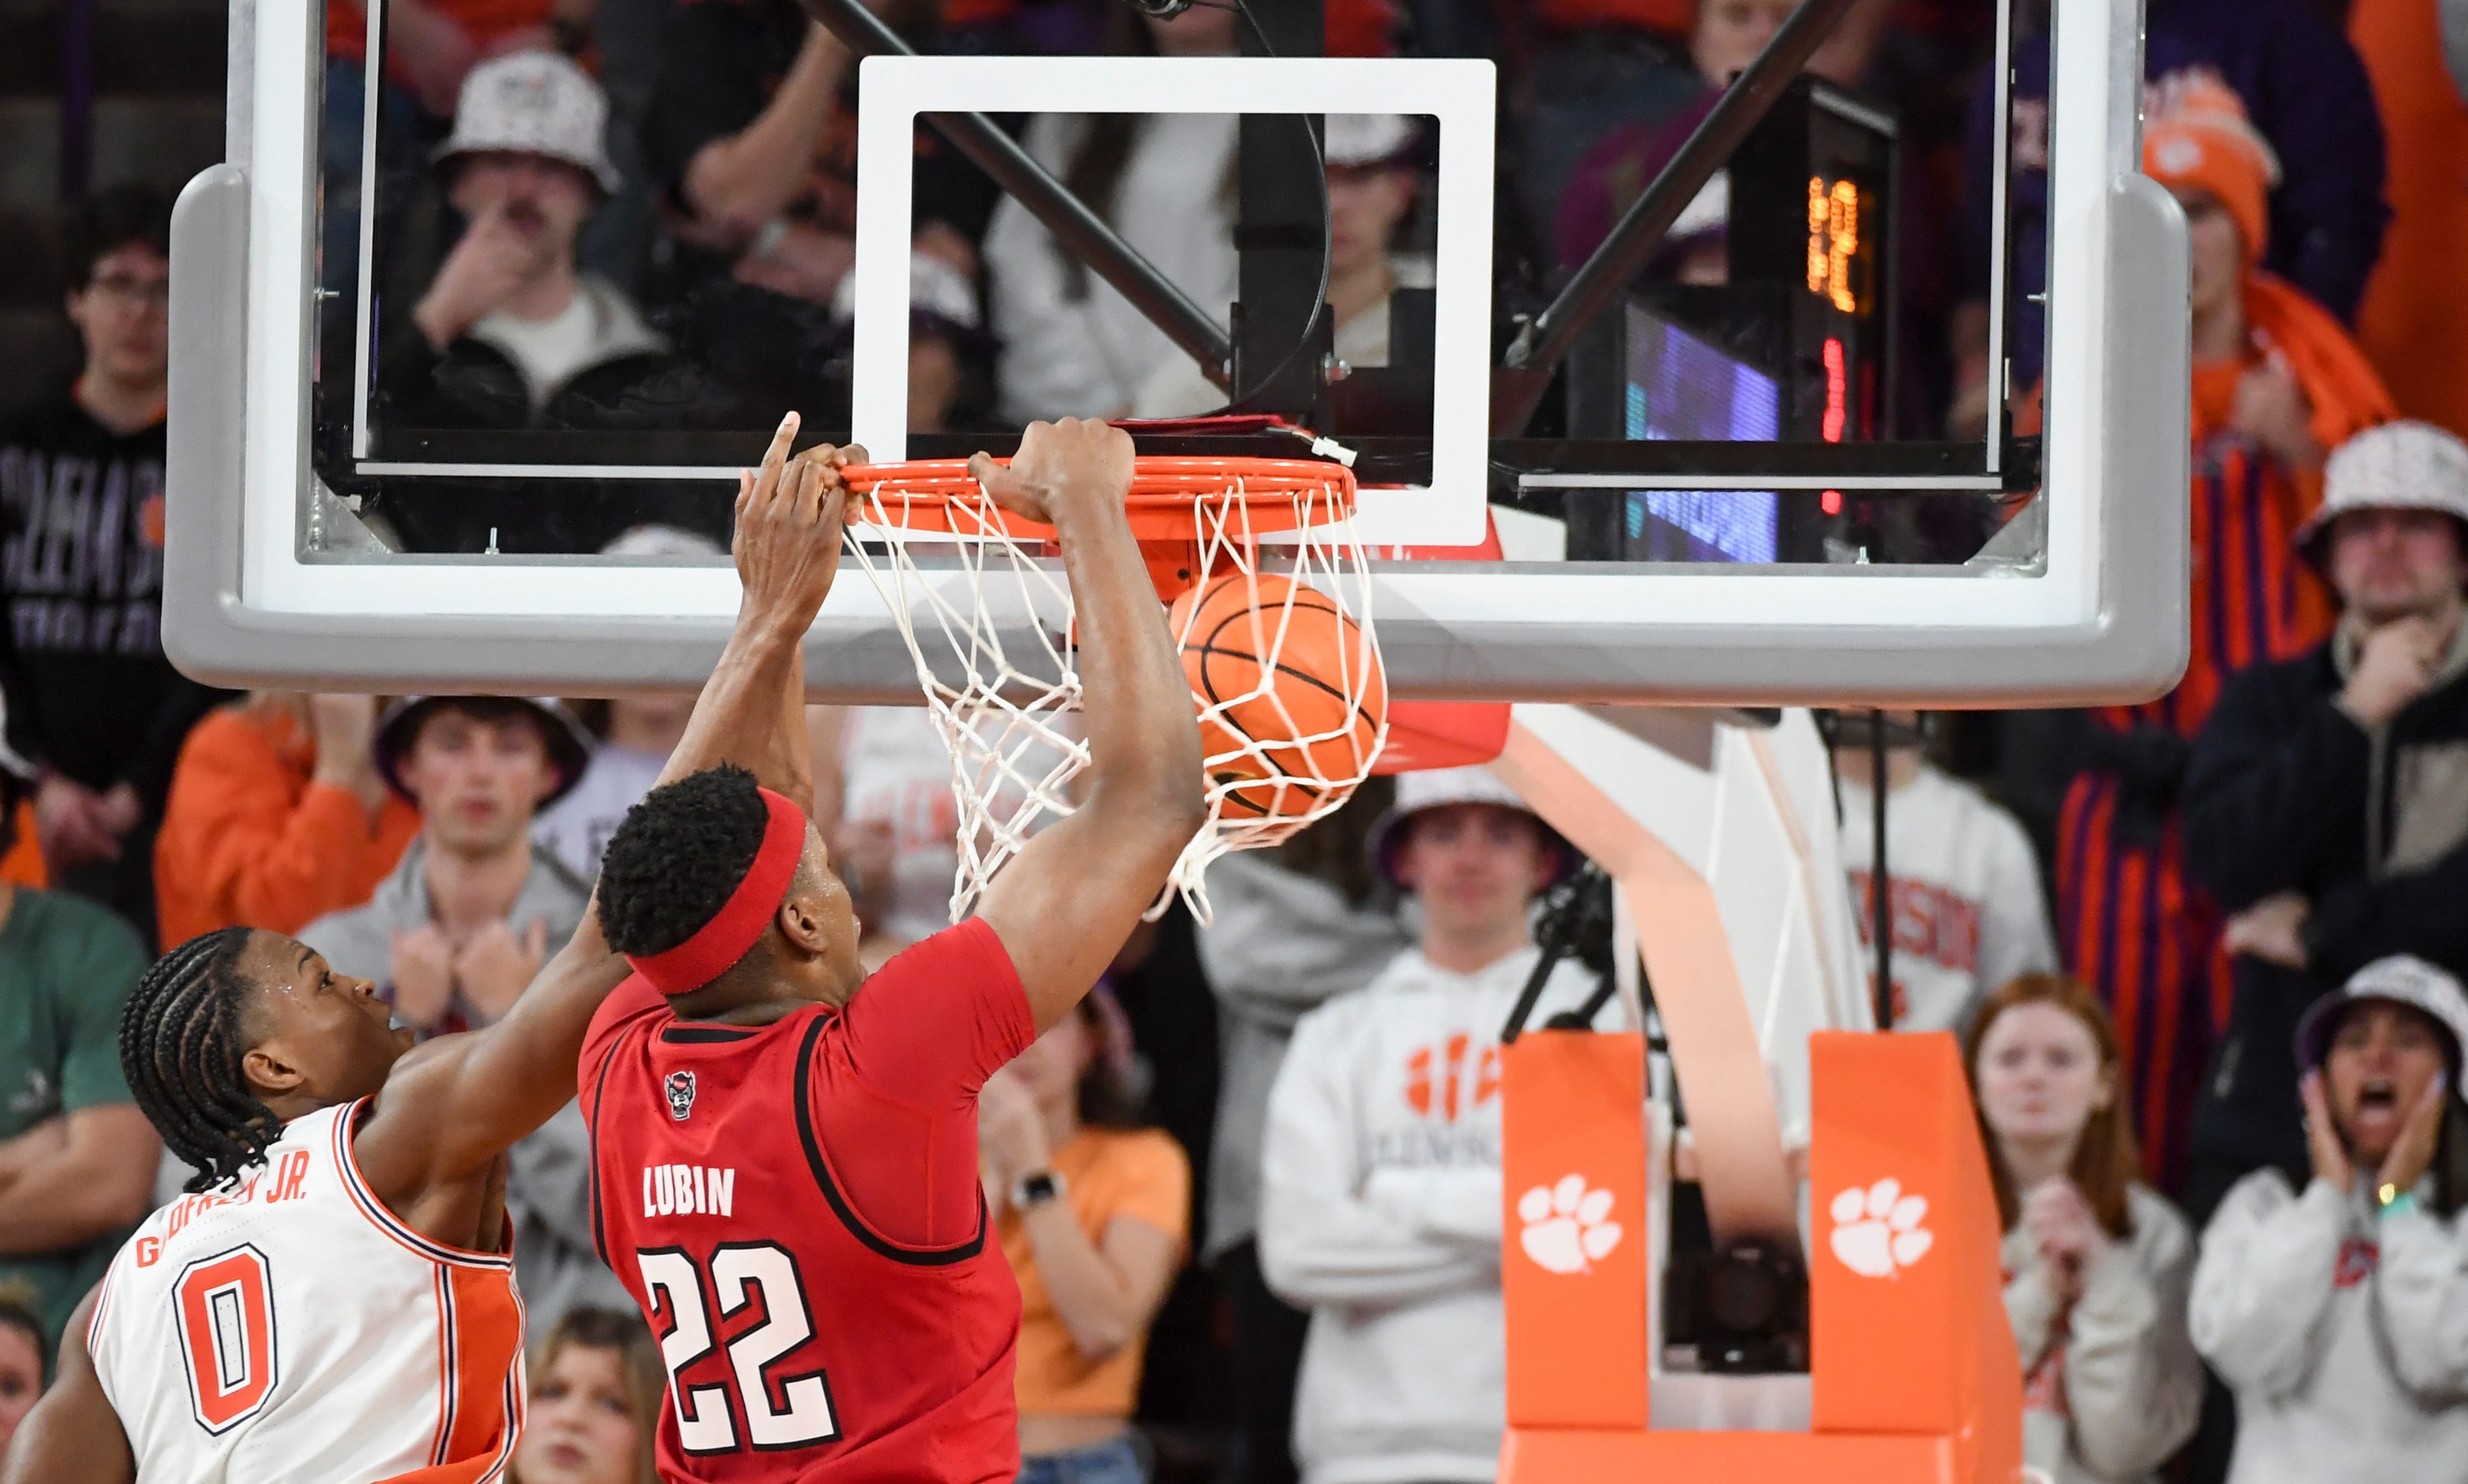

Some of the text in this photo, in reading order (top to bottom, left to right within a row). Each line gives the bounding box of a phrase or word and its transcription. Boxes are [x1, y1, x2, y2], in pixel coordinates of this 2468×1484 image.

[266, 1150, 309, 1203] JR.
[643, 1164, 735, 1217] LUBIN
[172, 1242, 278, 1437] 0
[636, 1238, 843, 1457] 22
